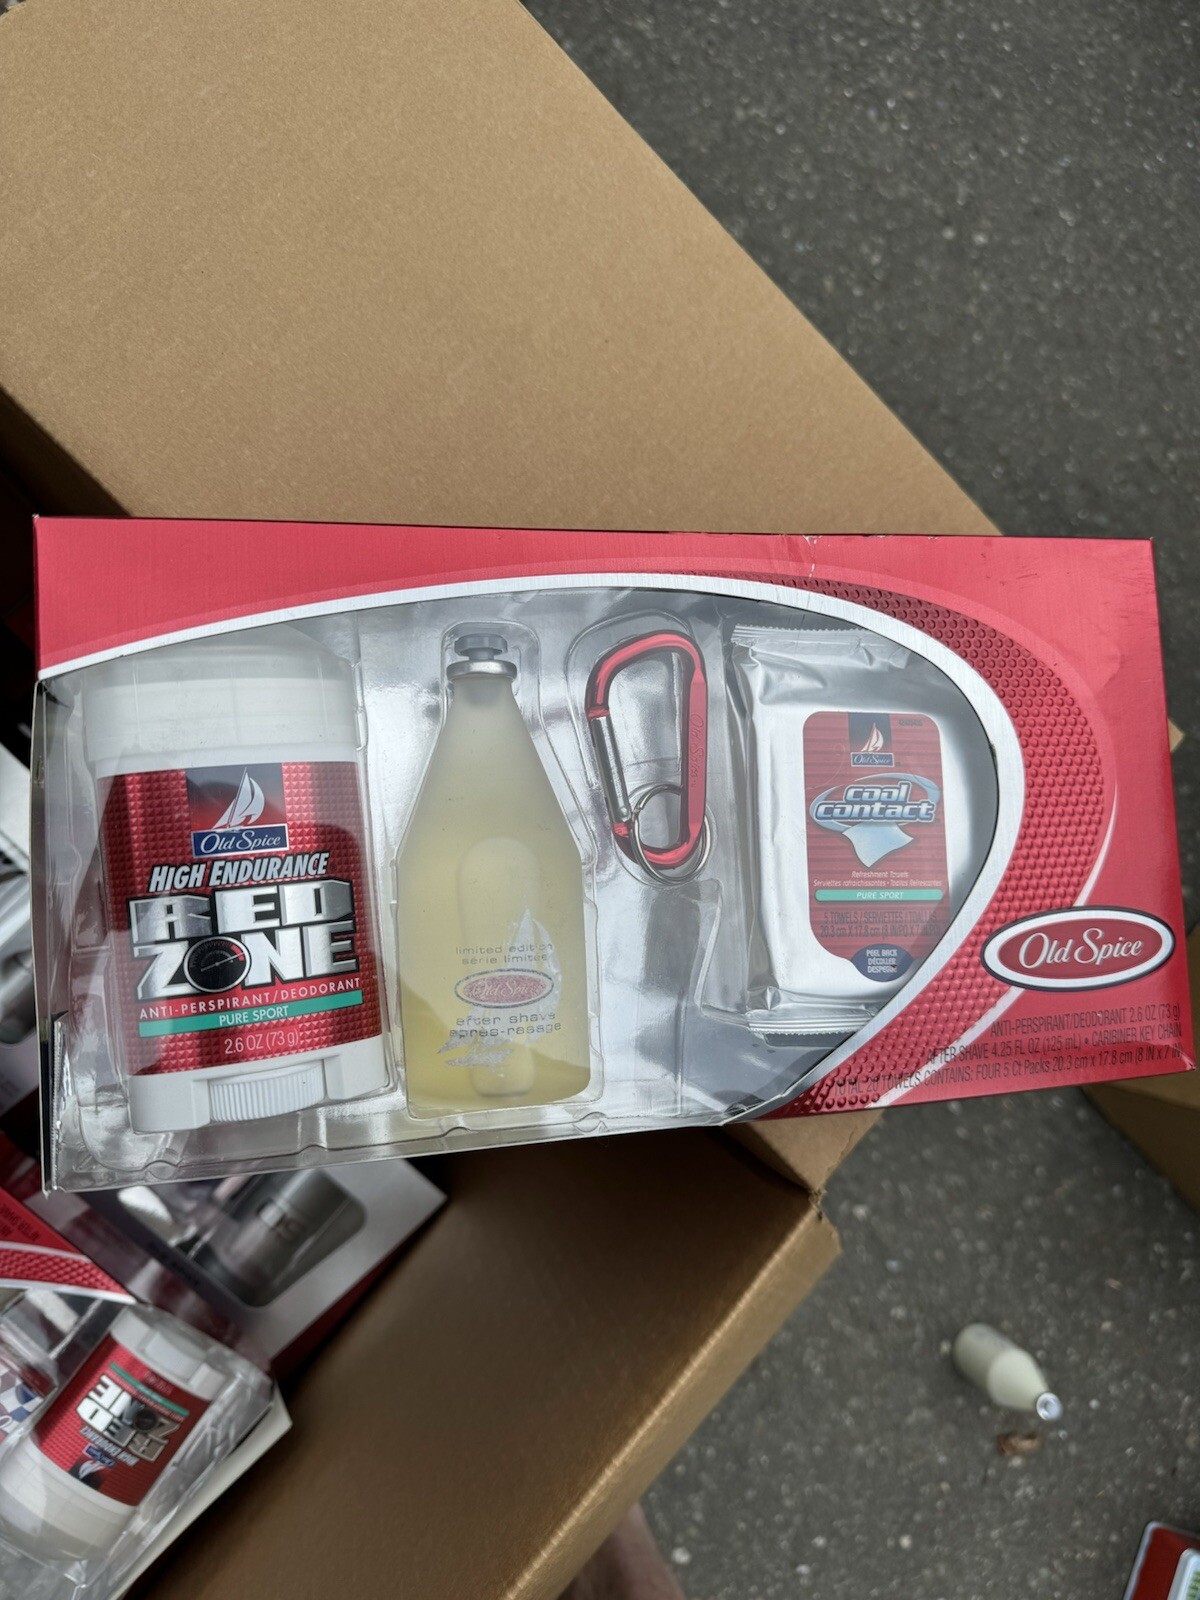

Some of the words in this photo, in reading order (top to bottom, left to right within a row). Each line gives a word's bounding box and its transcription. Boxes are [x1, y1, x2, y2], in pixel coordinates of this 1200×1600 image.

[844, 781, 910, 802] cool
[814, 801, 935, 822] contact
[200, 833, 235, 853] Old
[236, 830, 281, 852] Spice
[148, 864, 207, 893] HIGH
[208, 852, 331, 886] ENDURANCE
[856, 891, 877, 900] PURE
[880, 891, 904, 900] SPORT
[128, 879, 355, 944] RED
[829, 911, 858, 924] TOWELS
[132, 919, 359, 1000] ZONE
[455, 946, 503, 954] limited
[866, 949, 880, 957] PEEL
[881, 949, 898, 957] BACK
[1018, 932, 1074, 969] Old
[1074, 927, 1143, 966] Spice
[138, 976, 361, 1021] ANTI-PERSPIRANT/DEODORANT
[218, 1010, 250, 1027] PURE
[252, 1005, 290, 1022] SPORT
[990, 1007, 1127, 1038] ANTI-PERSPIRANT/DEODORANT
[1129, 1006, 1142, 1023] 2.6
[1144, 1004, 1157, 1021] OZ
[224, 1036, 245, 1055] 2.6
[246, 1034, 264, 1051] OZ
[266, 1031, 287, 1051] (73
[288, 1028, 300, 1048] g)
[925, 1045, 957, 1065] AFTER
[957, 1042, 990, 1062] SHAVE
[991, 1041, 1013, 1058] 4.25
[1014, 1039, 1026, 1056] FL
[1027, 1038, 1040, 1054] OZ
[1138, 1024, 1156, 1042] KEY
[1158, 1021, 1182, 1040] CHAIN
[881, 1071, 921, 1091] TOWELS
[923, 1065, 974, 1086] CONTAINS:
[976, 1063, 1001, 1080] FOUR
[1002, 1062, 1010, 1078] 5
[1011, 1061, 1023, 1077] Ct
[1024, 1058, 1050, 1075] Packs
[1052, 1056, 1072, 1072] 20.3
[1073, 1055, 1088, 1069] cm
[1099, 1049, 1117, 1066] 17.8
[1119, 1049, 1133, 1064] cm
[76, 1397, 170, 1463] RED
